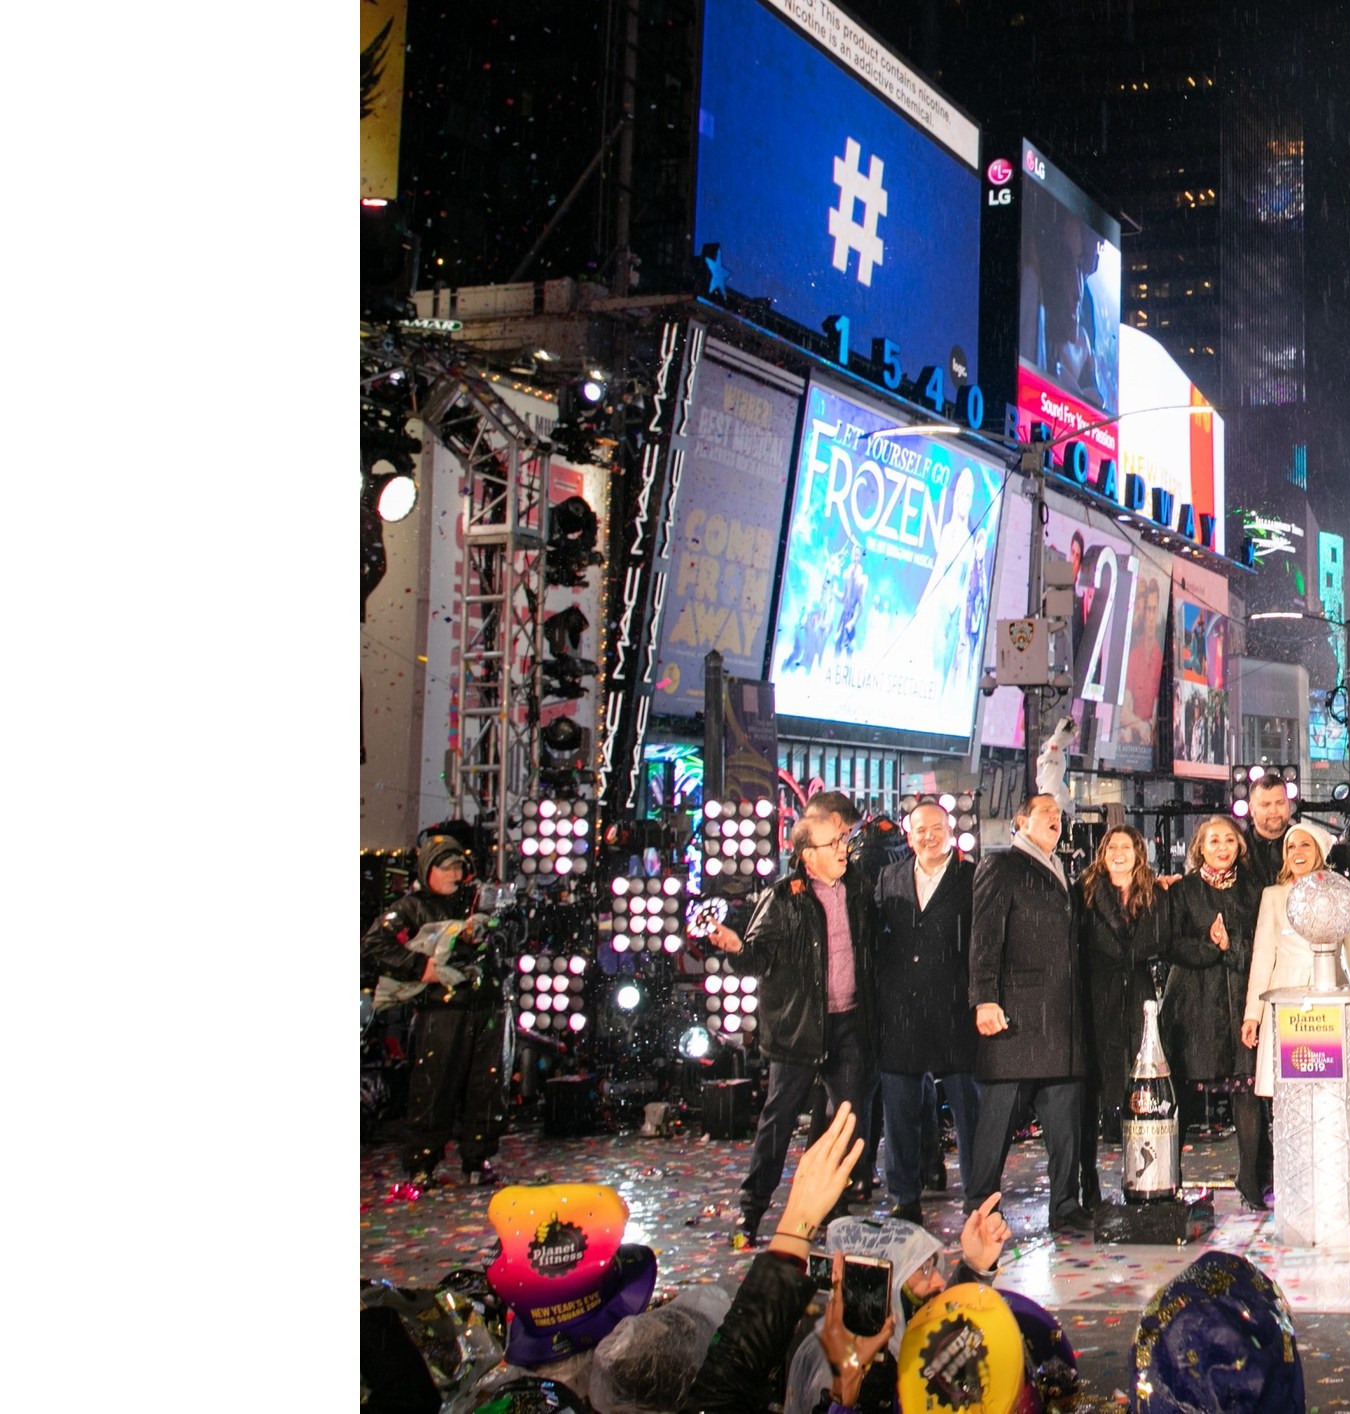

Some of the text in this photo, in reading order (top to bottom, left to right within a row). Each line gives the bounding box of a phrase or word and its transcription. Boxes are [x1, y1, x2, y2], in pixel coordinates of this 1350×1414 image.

[785, 0, 935, 128] Nicotine is an addictive chemical.
[820, 3, 951, 125] This product contains nicotine.
[1034, 157, 1045, 180] LG
[988, 188, 1012, 206] LG
[1041, 391, 1064, 421] Sound
[1064, 405, 1076, 428] For
[832, 418, 951, 487] LET YOURSELF GO
[800, 418, 947, 553] FROZEN
[684, 507, 774, 570] COME
[667, 600, 764, 656] AWAY
[1081, 545, 1140, 707] 21
[1289, 1013, 1326, 1025] planet
[1295, 1022, 1335, 1033] fitness
[1300, 1062, 1326, 1073] 2019
[533, 1242, 575, 1260] planet
[539, 1251, 583, 1266] fitness
[530, 1307, 550, 1320] NEW
[551, 1299, 583, 1316] YEAR'S
[534, 1316, 556, 1327] TIMES
[557, 1308, 586, 1323] SQUARE
